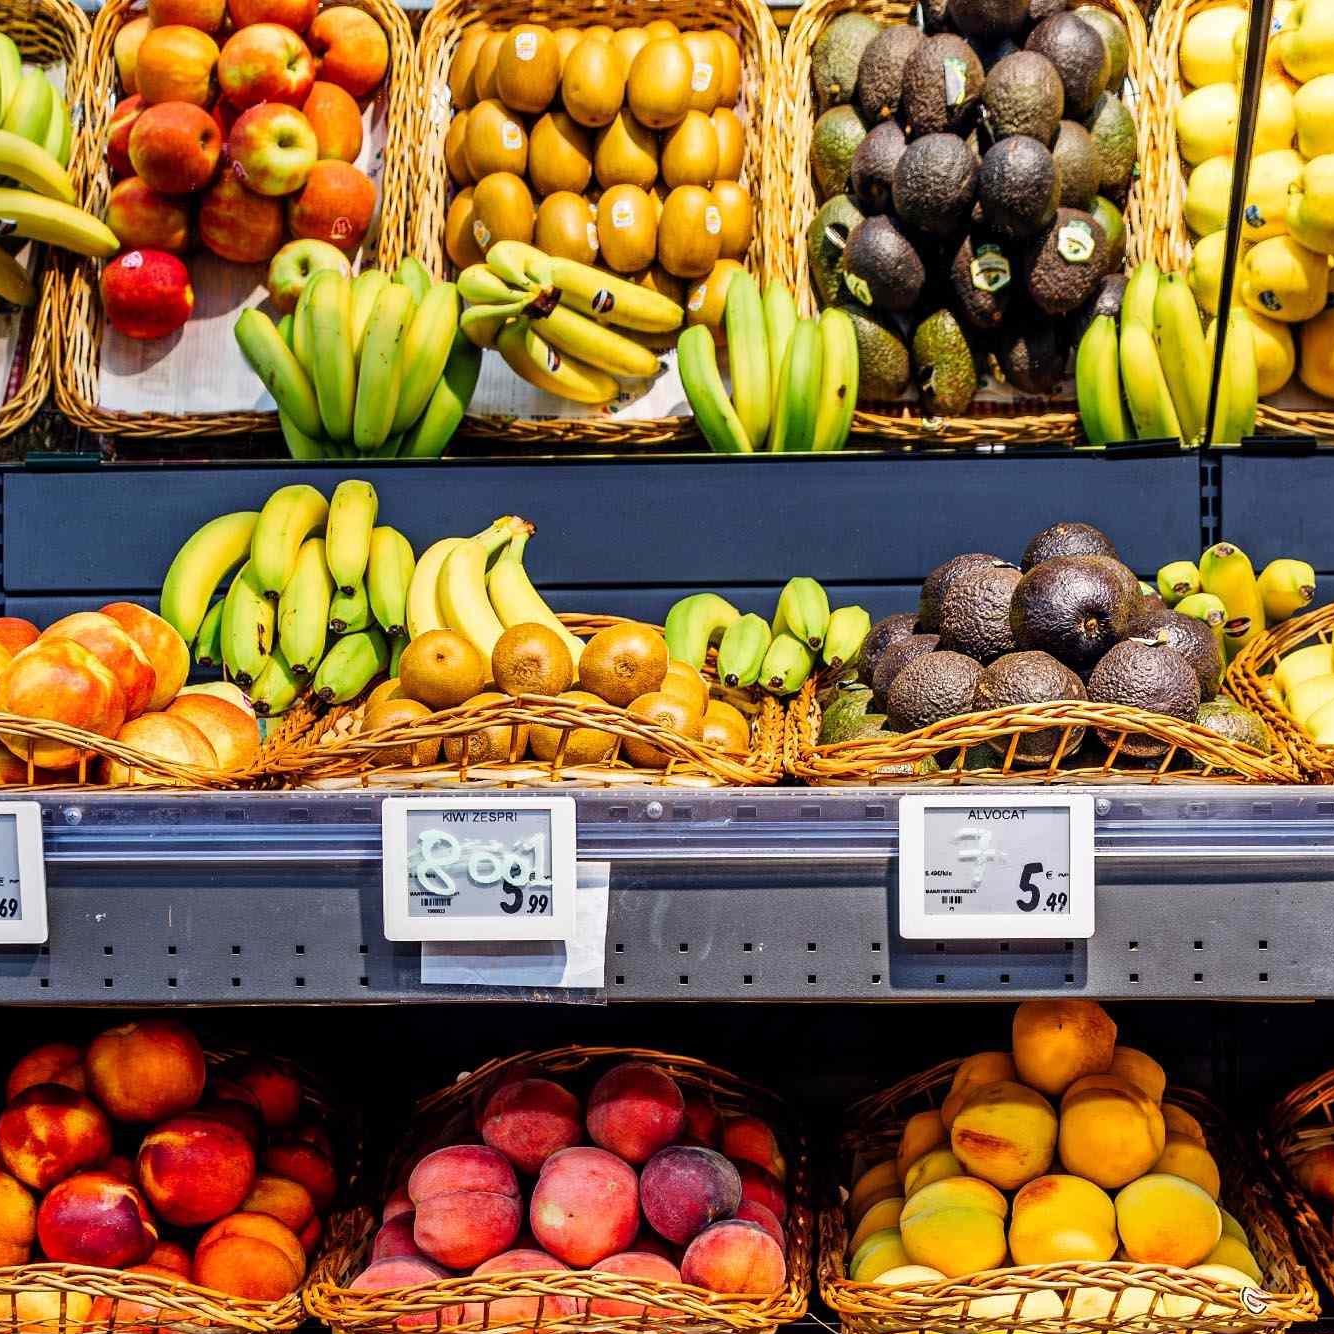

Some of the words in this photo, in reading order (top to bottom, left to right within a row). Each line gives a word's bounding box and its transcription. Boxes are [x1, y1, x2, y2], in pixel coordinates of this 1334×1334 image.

[442, 811, 469, 823] KIWI
[472, 811, 517, 823] ZESPRI
[968, 809, 1028, 820] ALVOCAT
